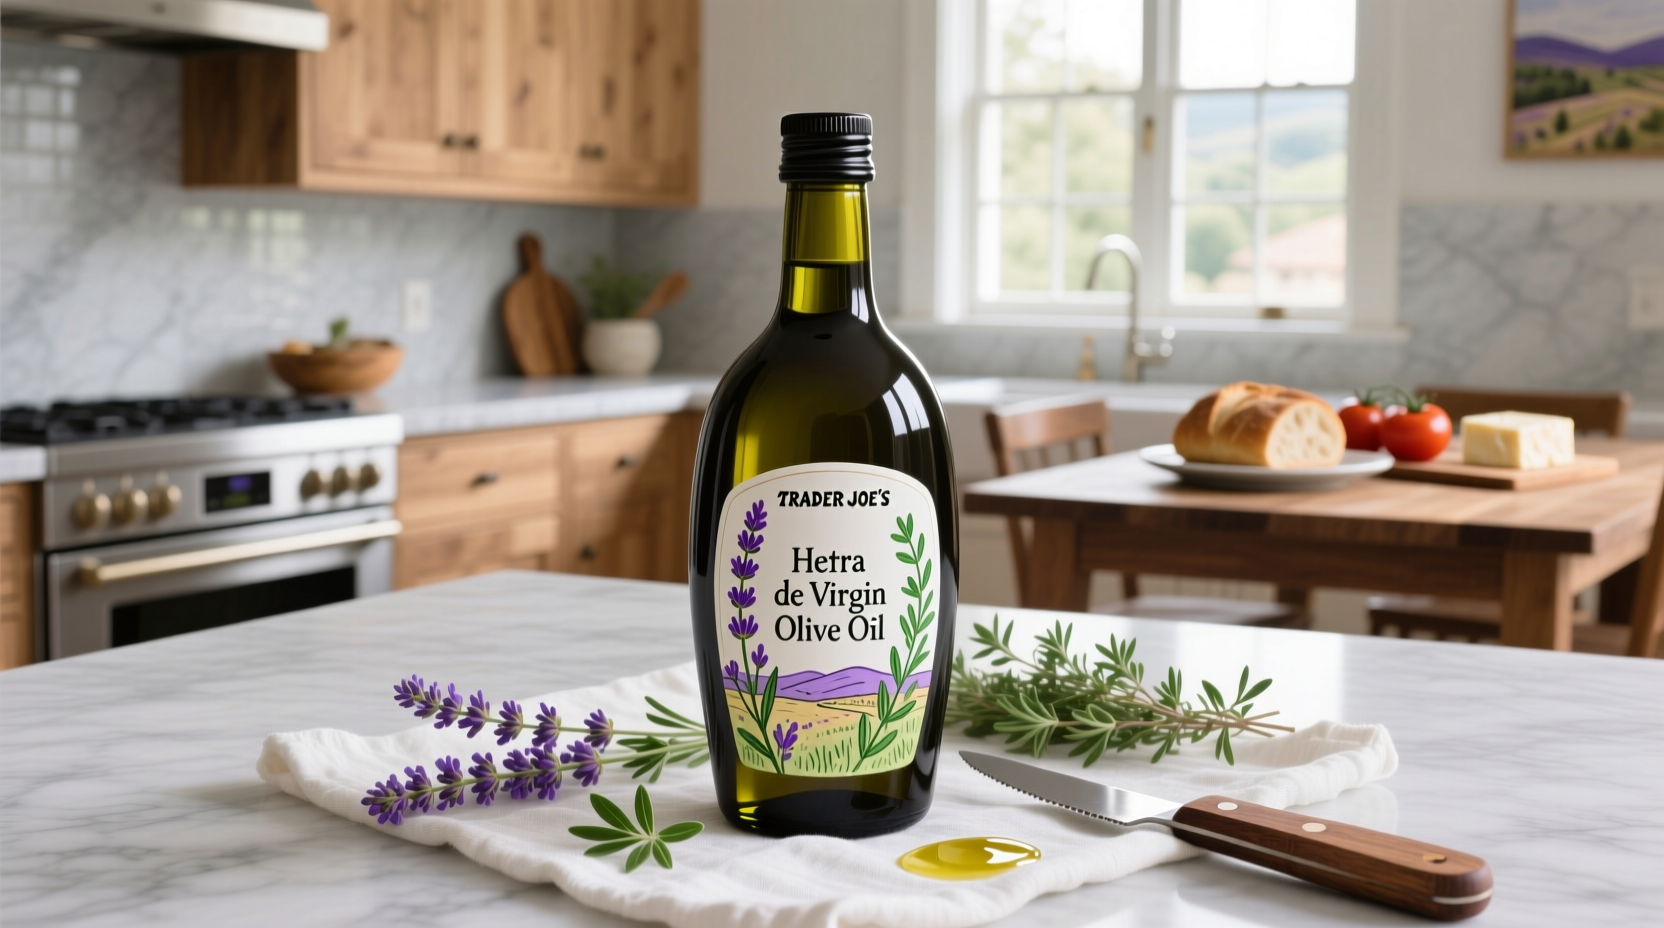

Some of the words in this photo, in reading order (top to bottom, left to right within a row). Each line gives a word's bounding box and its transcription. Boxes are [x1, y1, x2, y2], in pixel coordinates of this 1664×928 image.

[777, 490, 844, 507] TRADER
[847, 488, 891, 507] JOE'S
[791, 547, 866, 573] Hetra
[774, 579, 804, 606] de
[809, 582, 886, 614] Virgin
[774, 615, 841, 642] Olive
[848, 614, 885, 641] Oil
